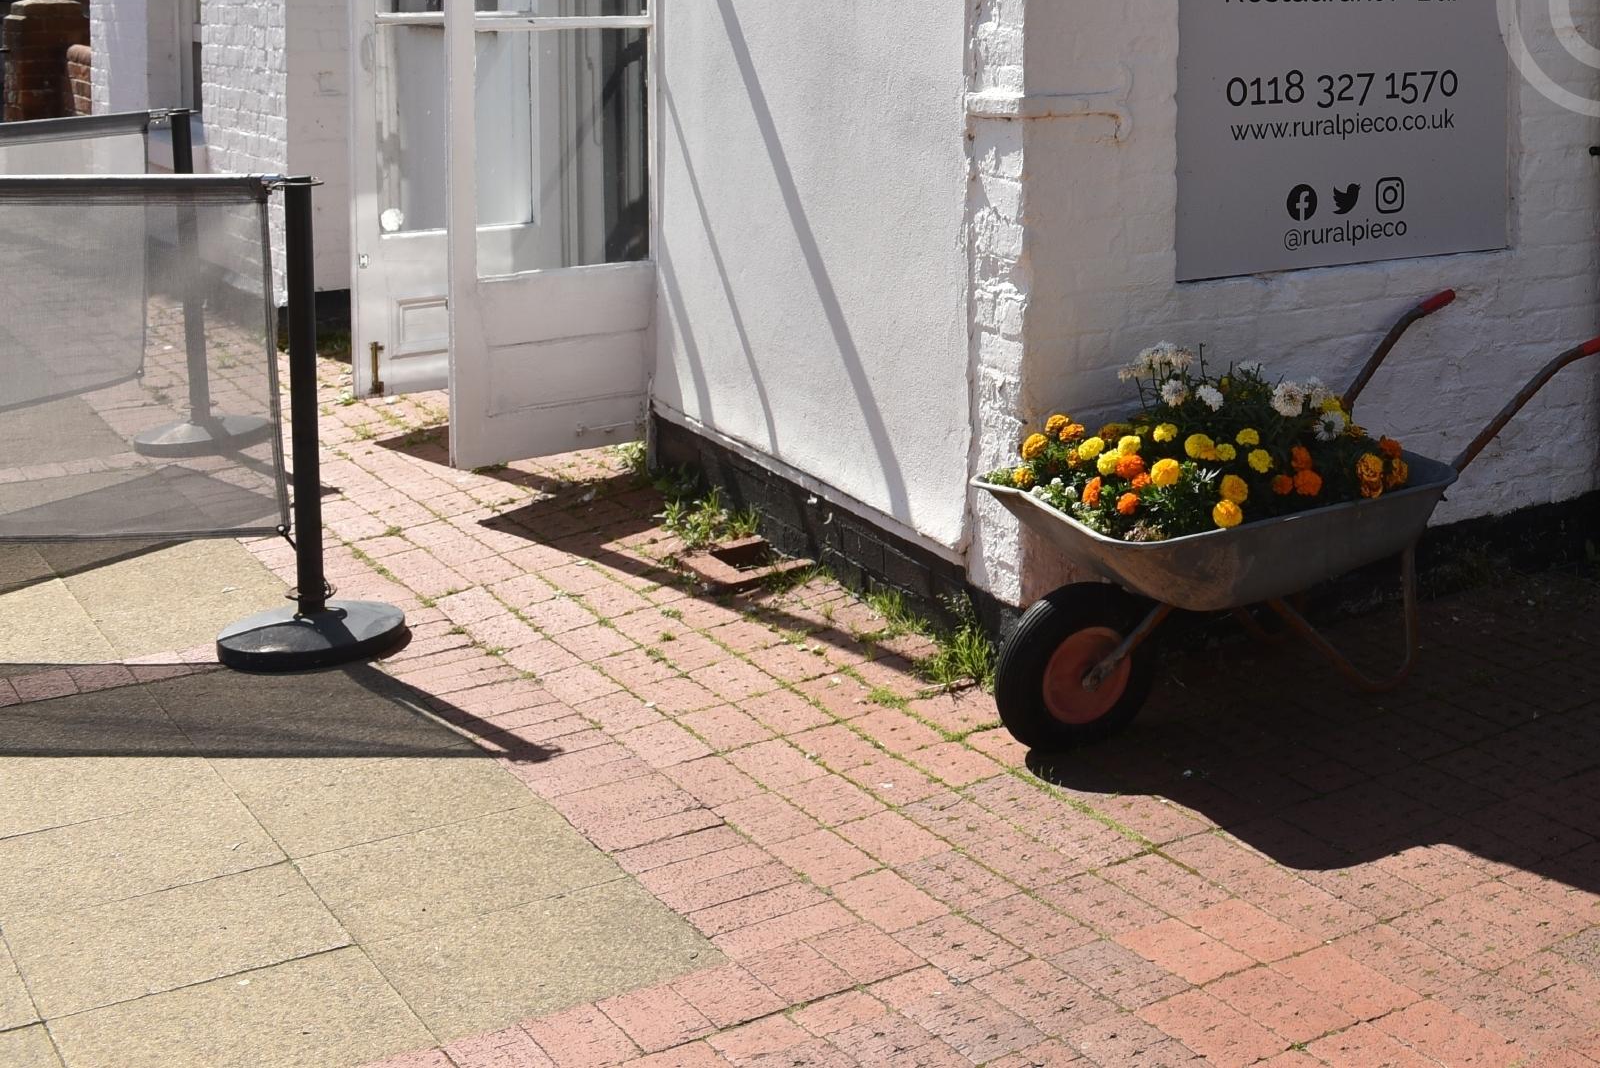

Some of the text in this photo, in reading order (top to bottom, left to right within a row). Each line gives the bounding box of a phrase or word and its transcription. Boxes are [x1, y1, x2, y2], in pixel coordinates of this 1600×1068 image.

[1226, 69, 1458, 109] 0118 327 1570
[1230, 108, 1455, 141] www.ruralpieco.co.uk
[1283, 218, 1408, 251] @ruralpieco
